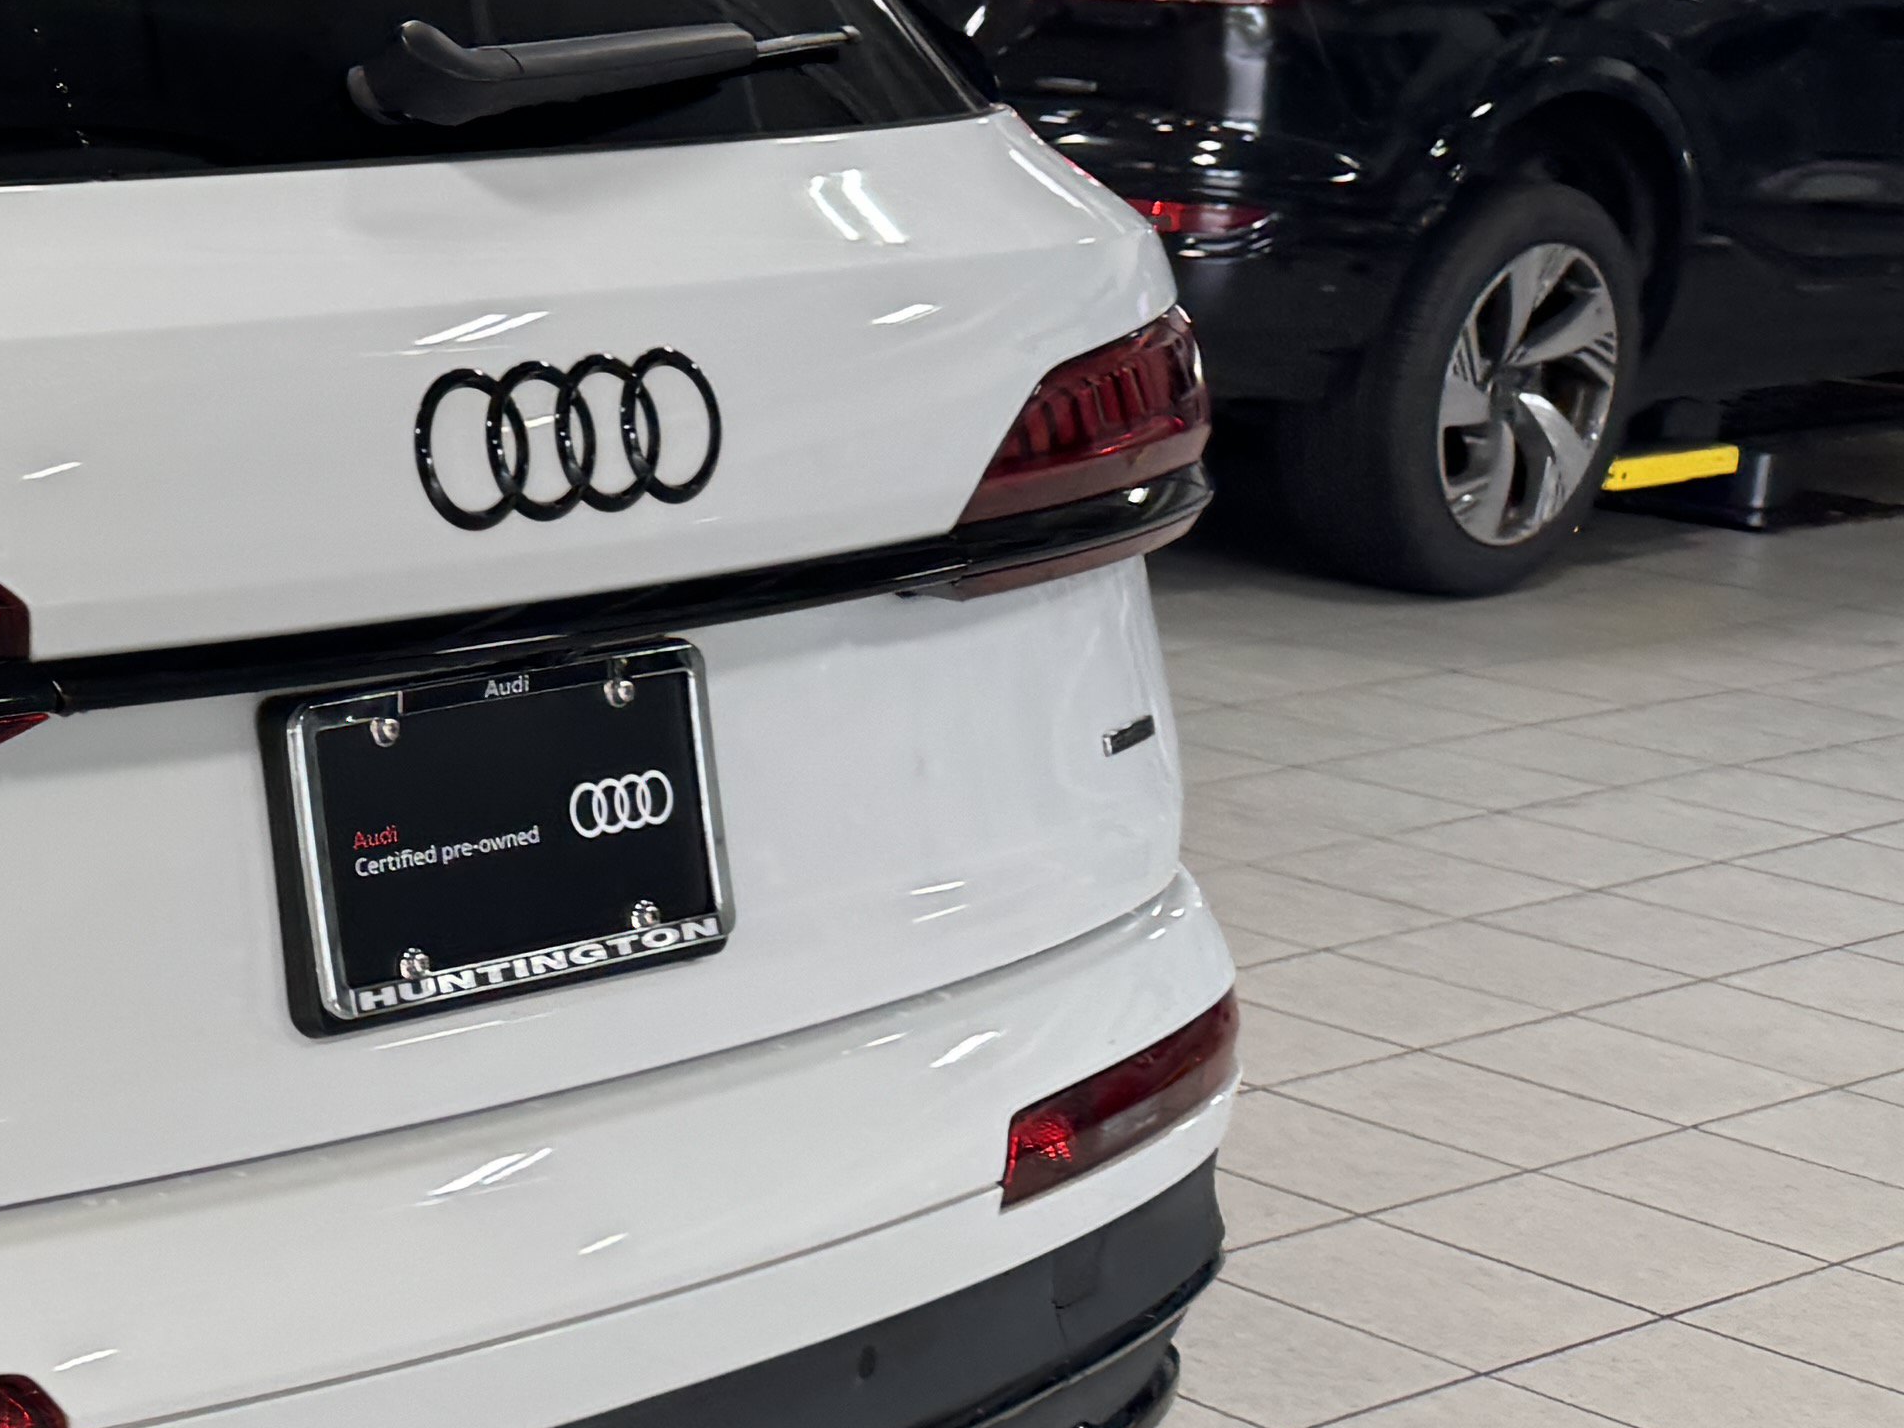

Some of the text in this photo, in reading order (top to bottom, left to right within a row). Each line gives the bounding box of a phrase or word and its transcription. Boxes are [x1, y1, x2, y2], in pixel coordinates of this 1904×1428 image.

[484, 674, 530, 699] Audi
[353, 824, 399, 851] Audi
[354, 824, 542, 877] Certified pre-owned
[359, 917, 721, 1013] HUNTINGTON
